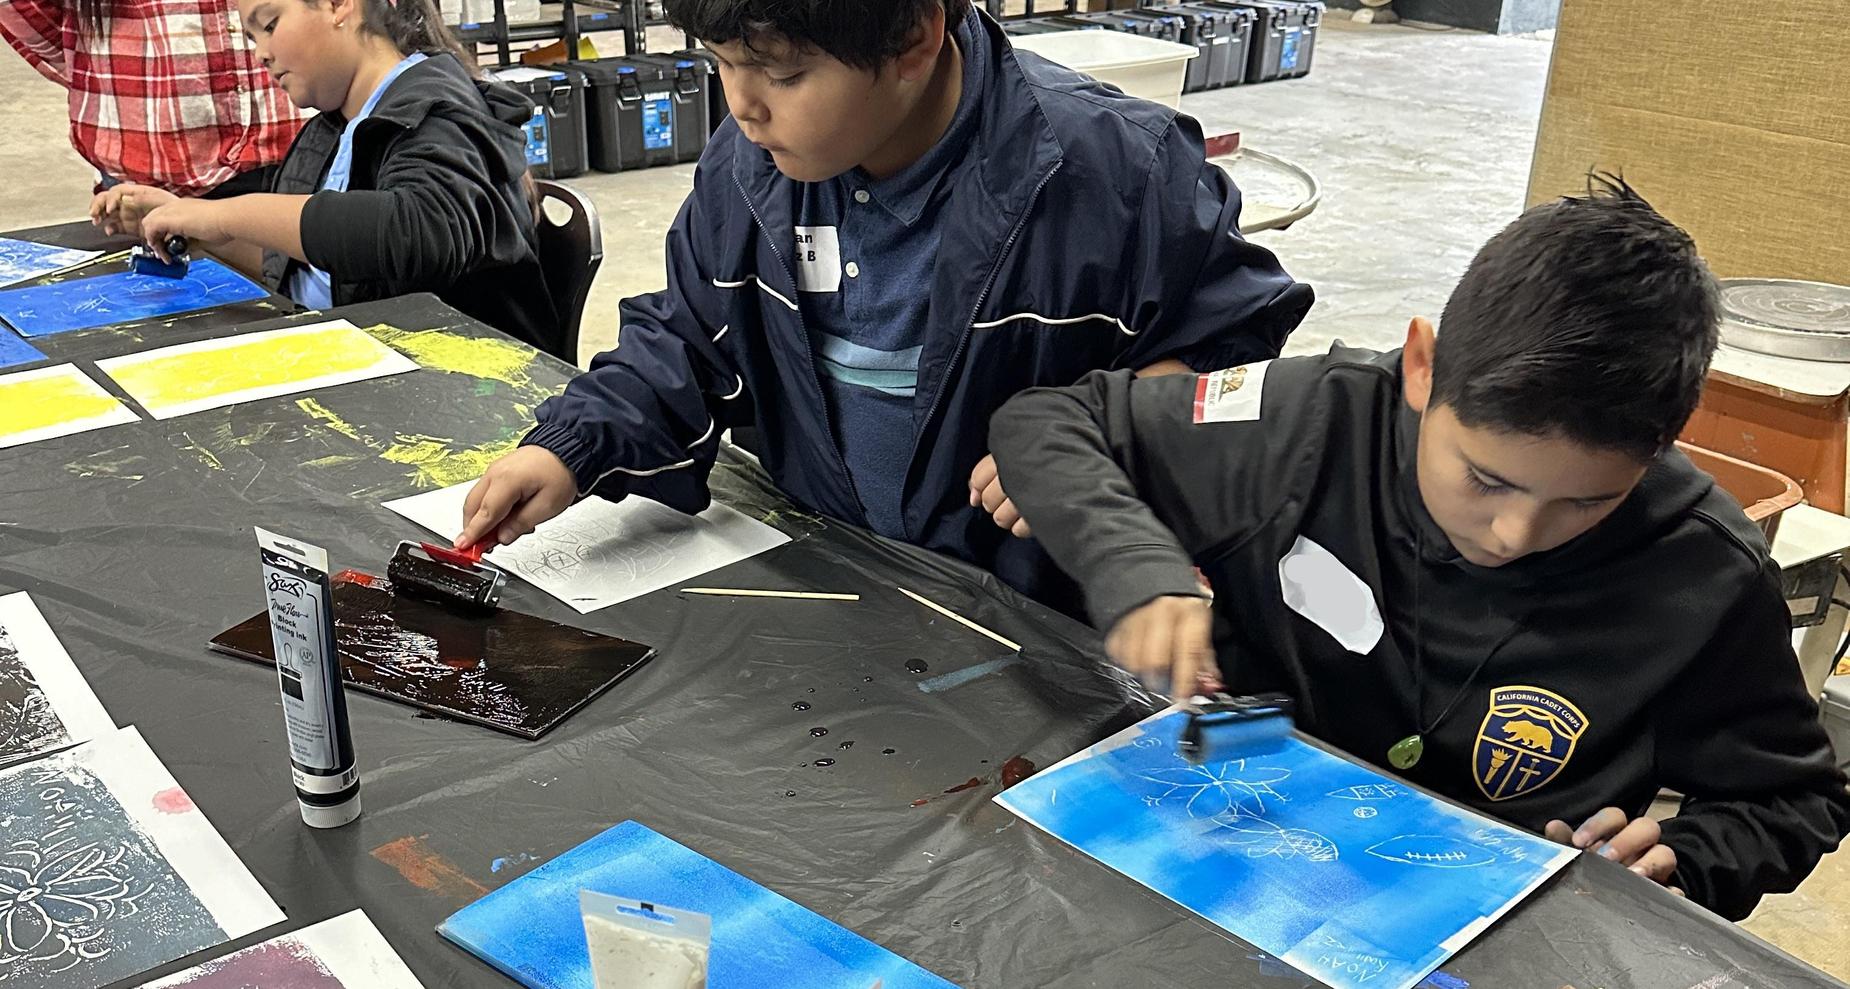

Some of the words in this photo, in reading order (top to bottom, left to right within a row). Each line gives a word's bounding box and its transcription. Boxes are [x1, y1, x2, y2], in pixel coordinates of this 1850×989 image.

[808, 250, 816, 262] B
[277, 614, 297, 628] Block
[296, 631, 308, 642] Ink
[1497, 693, 1539, 702] CALIFORNIA
[1540, 698, 1562, 712] CADET
[1561, 709, 1581, 729] CORPS
